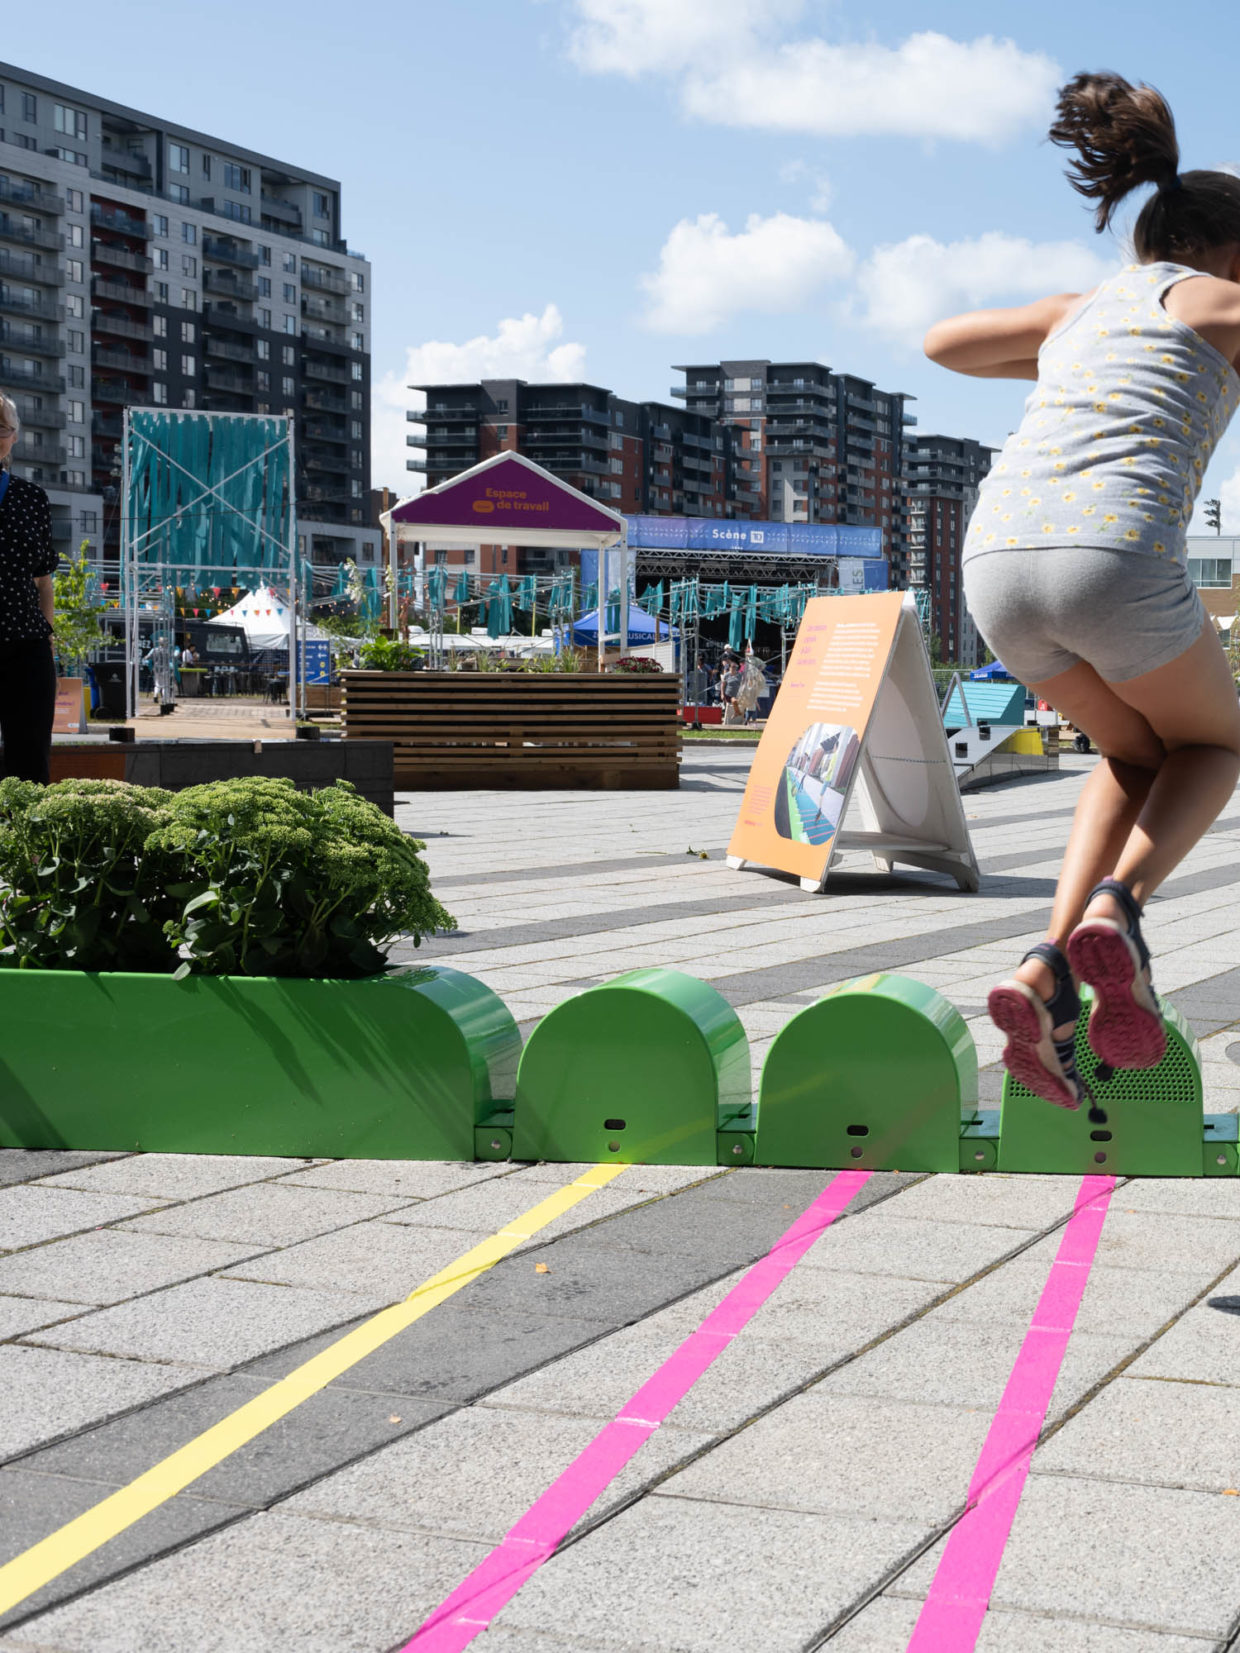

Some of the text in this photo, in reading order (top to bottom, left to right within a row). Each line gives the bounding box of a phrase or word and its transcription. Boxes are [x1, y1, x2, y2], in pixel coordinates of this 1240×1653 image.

[486, 487, 527, 499] Espace
[497, 500, 512, 509] de
[712, 529, 747, 540] Scène
